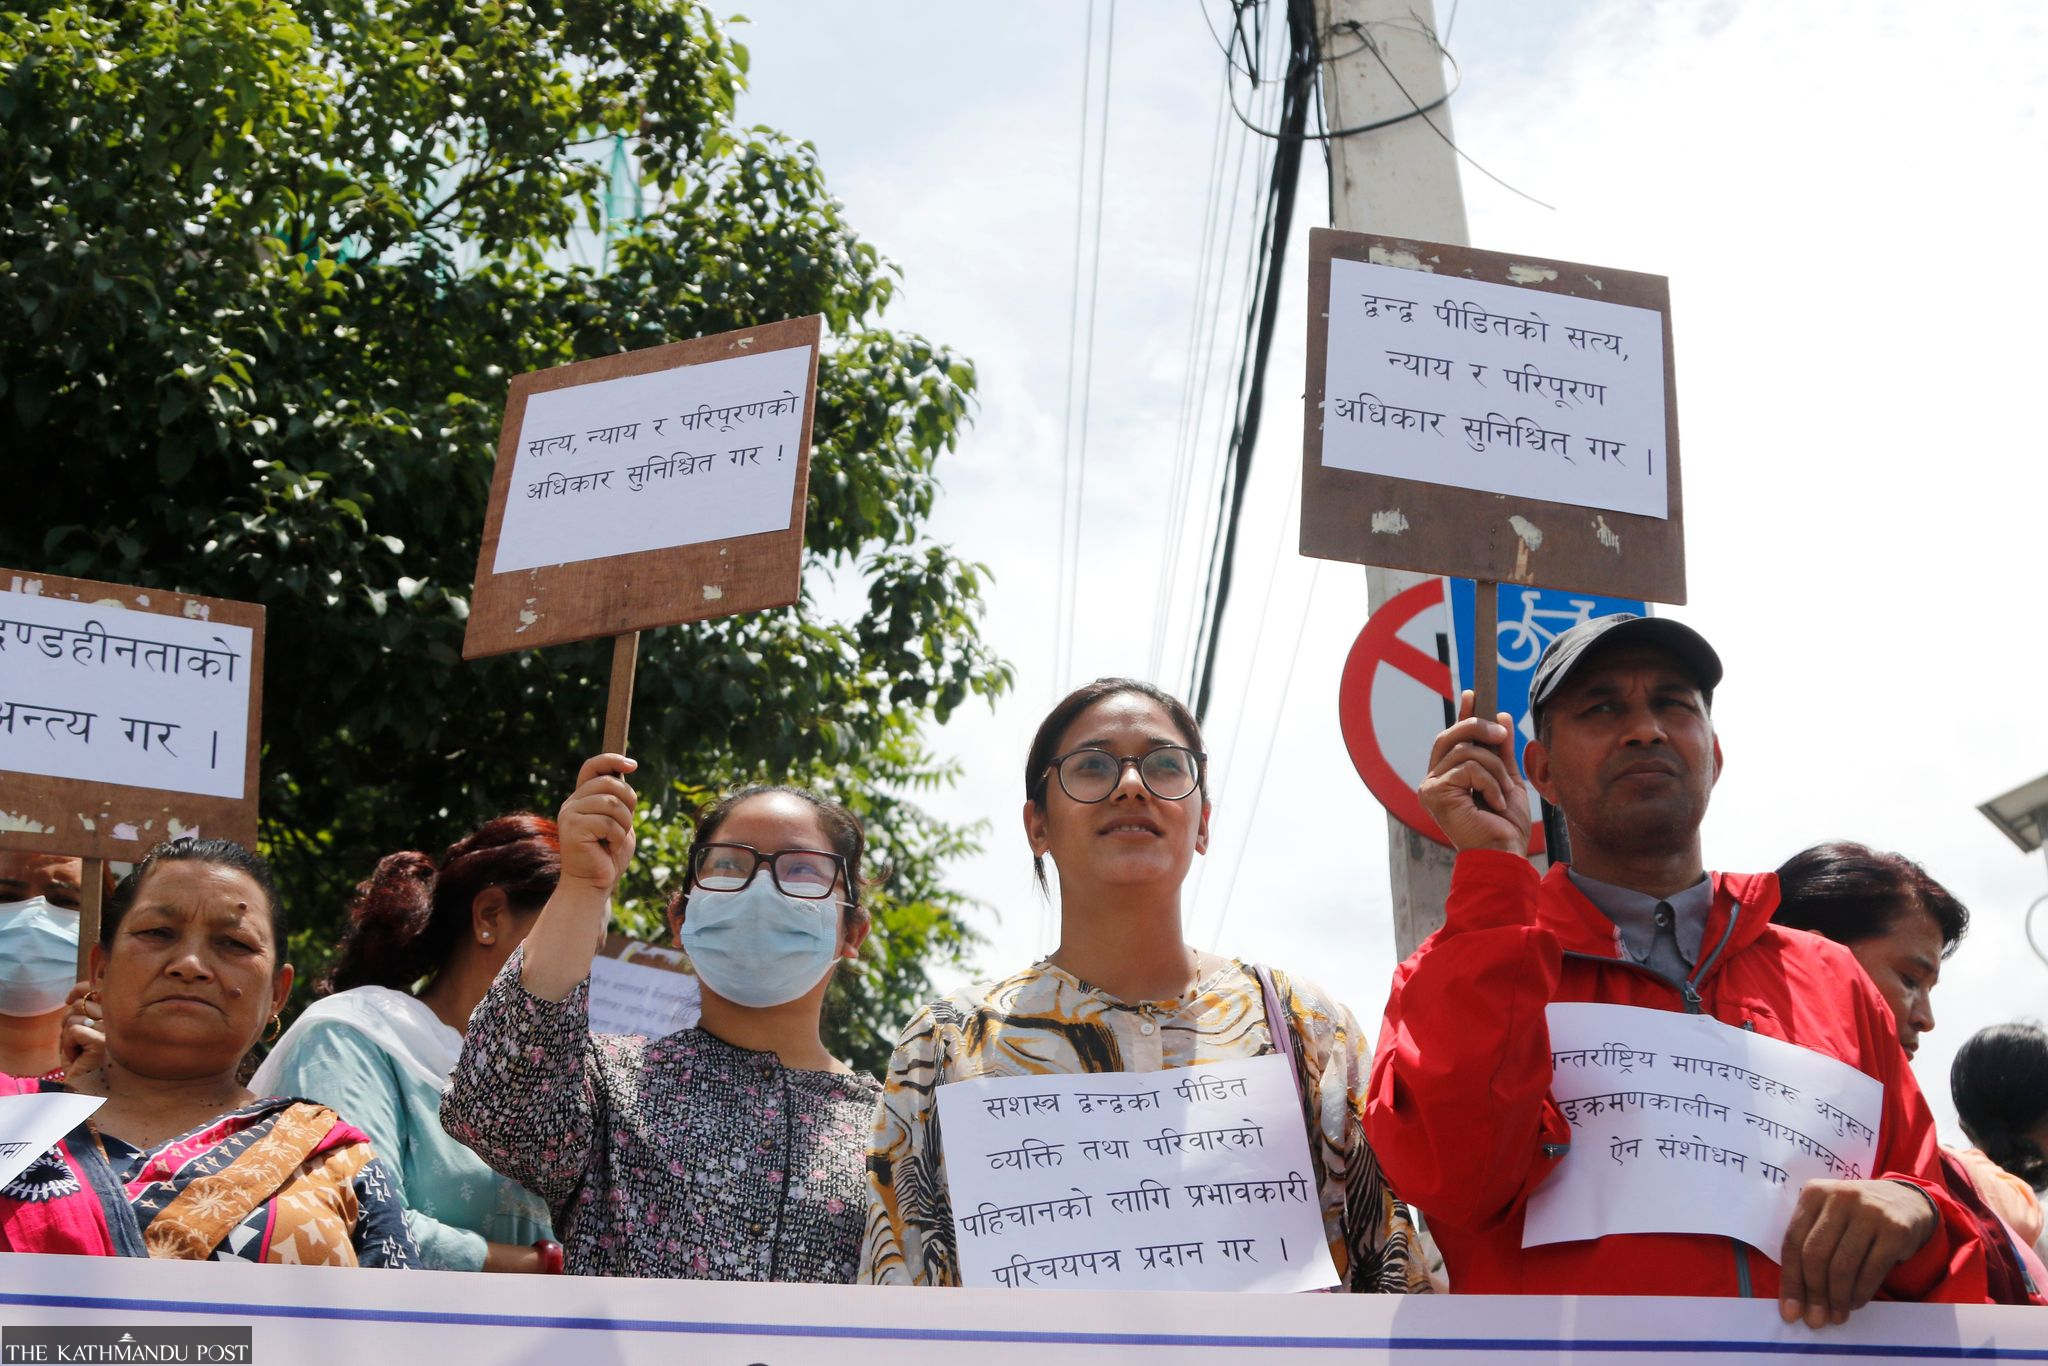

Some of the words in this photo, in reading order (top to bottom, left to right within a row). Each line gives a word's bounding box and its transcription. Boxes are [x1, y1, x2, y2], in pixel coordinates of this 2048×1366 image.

[1362, 294, 1419, 322] द्वन्द्व
[1433, 299, 1550, 343] पीडितको
[1564, 327, 1628, 361] सत्य,
[1385, 351, 1454, 381] न्याय
[1468, 364, 1488, 388] र
[1502, 363, 1607, 408] परिपूरण
[528, 434, 577, 457] सत्य,
[586, 423, 641, 444] न्याय
[652, 418, 668, 436] र
[680, 390, 800, 432] परिपूरणको
[1335, 392, 1446, 437] अधिकार
[1461, 412, 1575, 464] सुनिश्चित्
[1585, 437, 1626, 465] गर
[527, 471, 615, 499] अधिकार
[626, 452, 717, 491] सुनिश्चित
[728, 446, 764, 466] गर
[778, 444, 783, 461] !
[120, 717, 181, 757] गर
[982, 1094, 1061, 1120] सशस्त्र
[1074, 1090, 1160, 1113] द्वन्द्वका
[1173, 1075, 1247, 1103] पीडित
[1557, 1092, 1731, 1127] ङ्क्रमणकालीन
[1815, 1098, 1875, 1147] अनुरूप
[986, 1138, 1065, 1170] व्यक्ति
[1078, 1140, 1130, 1161] तथा
[1143, 1118, 1264, 1156] परिवारको
[1610, 1136, 1643, 1166] ऐन
[1656, 1134, 1749, 1173] संशोधन
[1760, 1161, 1790, 1190] गर
[959, 1188, 1093, 1237] पहिचानको
[1106, 1179, 1171, 1213] लागि
[1184, 1171, 1308, 1207] प्रभावकारी
[992, 1250, 1122, 1287] परिचयपत्र
[1135, 1242, 1204, 1270] प्रदान
[1217, 1239, 1256, 1262] गर
